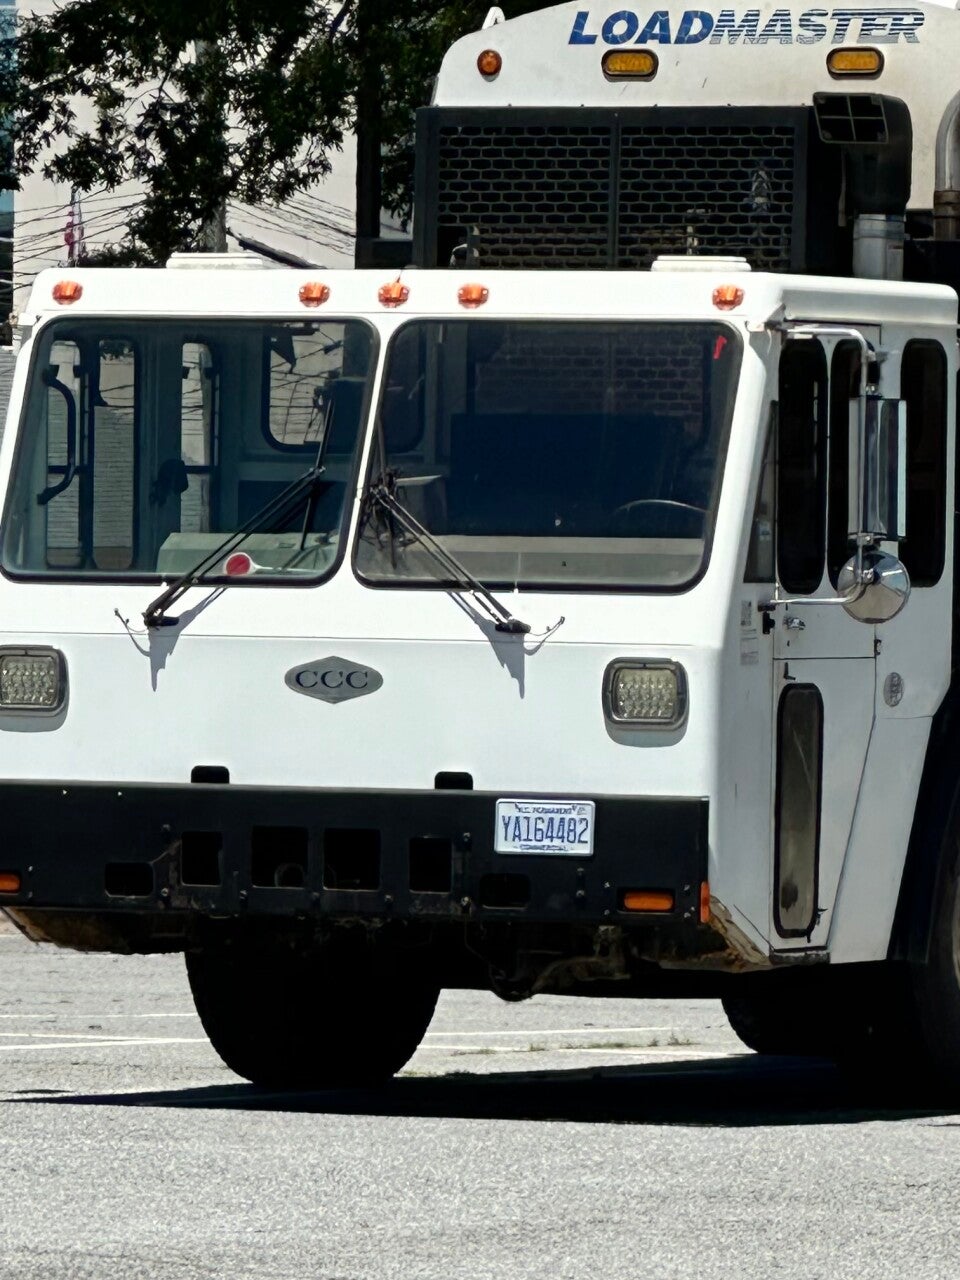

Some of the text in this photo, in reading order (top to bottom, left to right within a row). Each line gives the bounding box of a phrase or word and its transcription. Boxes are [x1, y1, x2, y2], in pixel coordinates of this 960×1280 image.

[568, 8, 925, 45] LOADMASTER
[295, 670, 368, 689] CCC
[502, 815, 588, 844] YA164482
